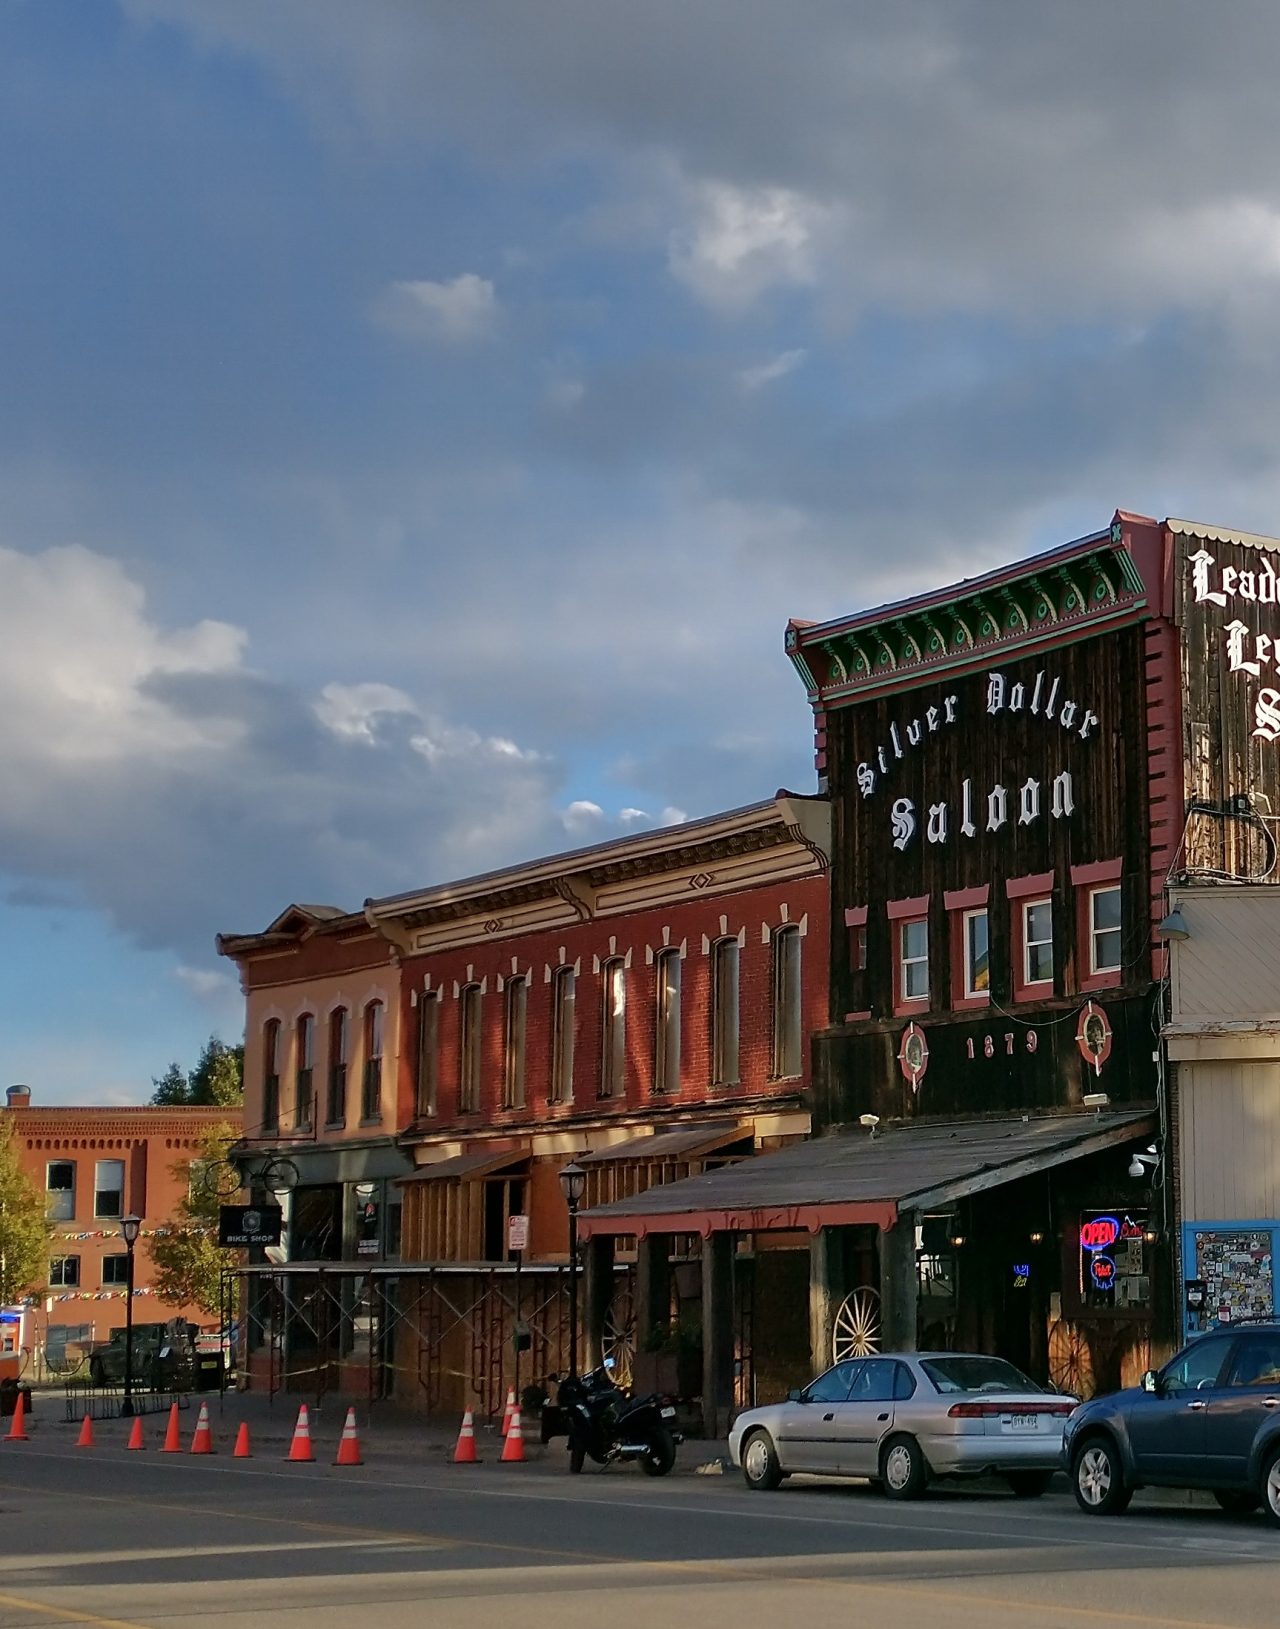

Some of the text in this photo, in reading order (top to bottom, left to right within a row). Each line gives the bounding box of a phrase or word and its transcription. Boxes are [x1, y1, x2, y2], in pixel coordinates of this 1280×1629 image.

[857, 669, 1099, 799] Silver Dollar
[891, 770, 1075, 851] Saloon
[966, 1030, 1038, 1059] 1879
[226, 1235, 274, 1243] BIKE SHOP
[1081, 1222, 1115, 1245] OPEN
